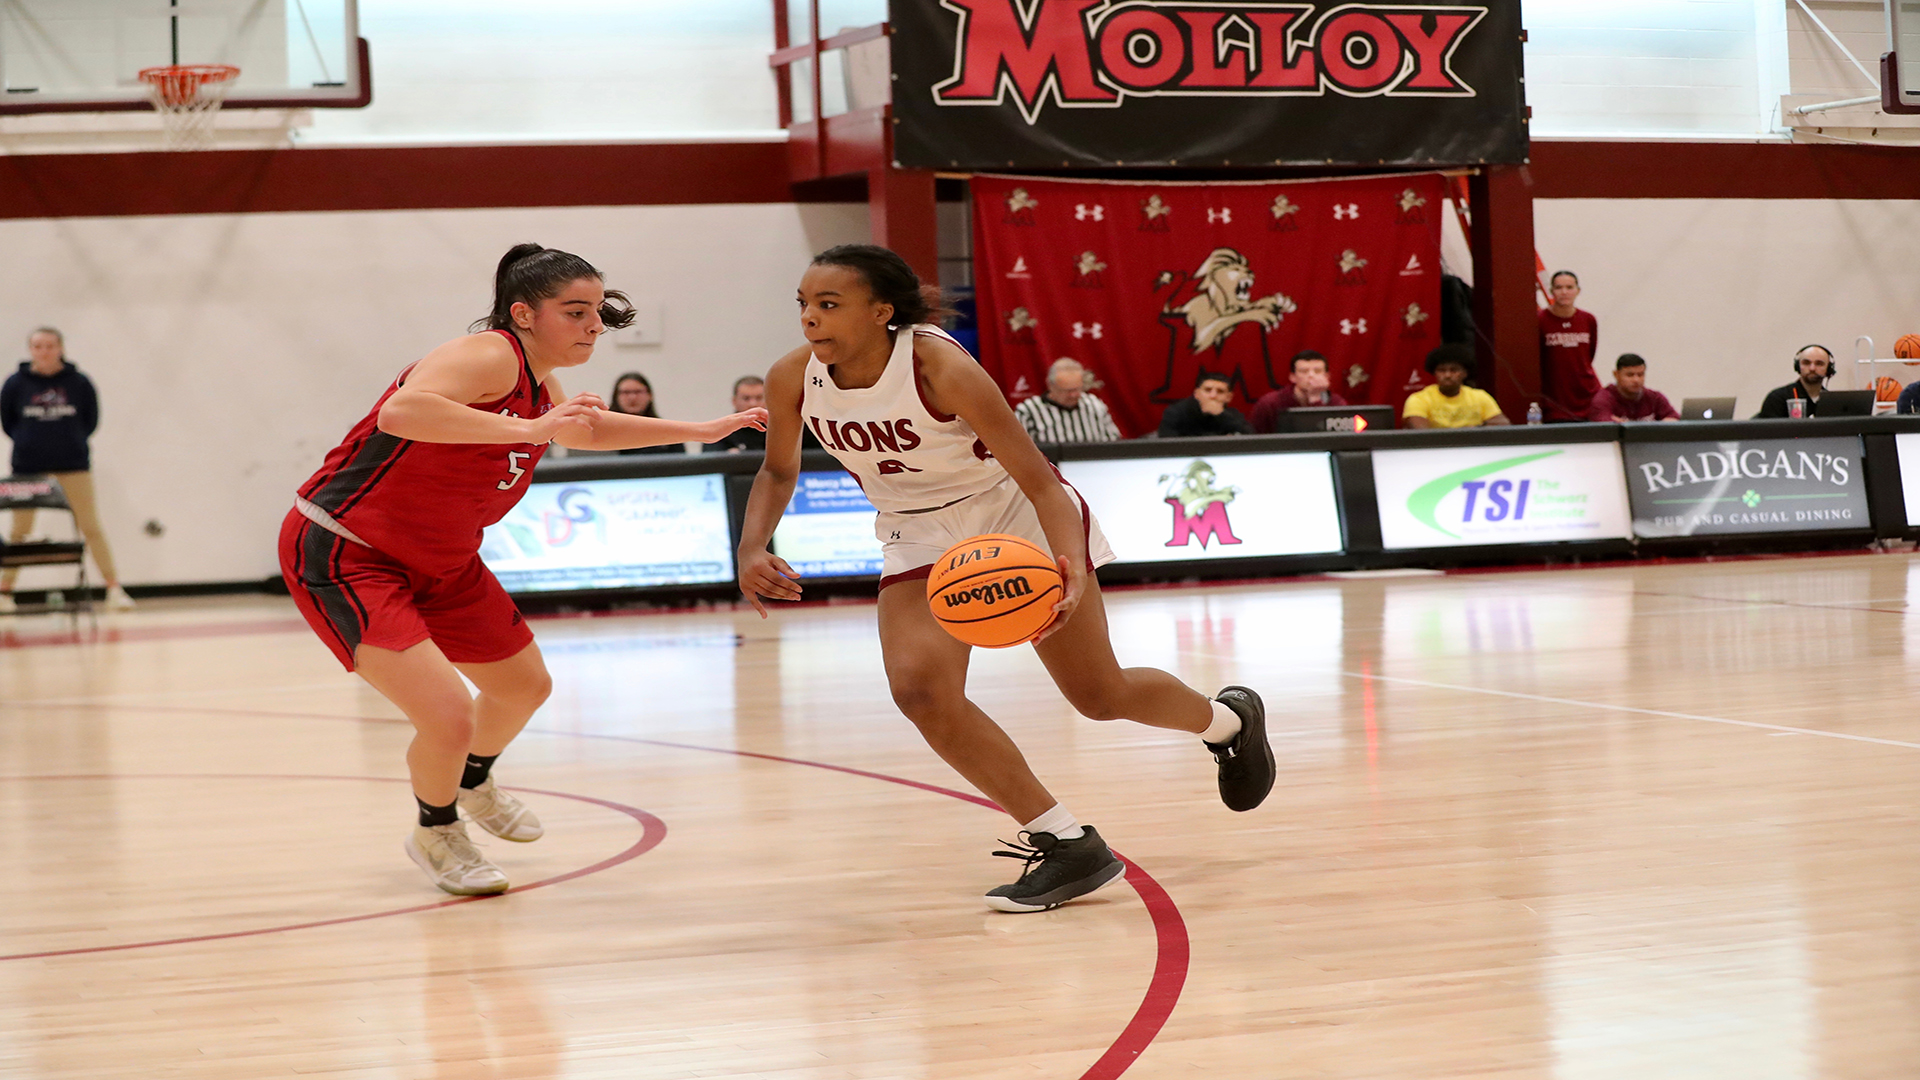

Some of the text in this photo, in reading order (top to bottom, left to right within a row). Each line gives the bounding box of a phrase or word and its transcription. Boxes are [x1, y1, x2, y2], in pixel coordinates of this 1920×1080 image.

[932, 0, 1488, 125] MOLLOY
[810, 415, 922, 453] LIONS
[496, 450, 531, 491] 5
[1536, 479, 1561, 490] The
[1639, 448, 1849, 493] RADIGAN'S
[1461, 478, 1531, 524] TSI
[1692, 514, 1724, 526] AND
[1729, 511, 1790, 525] CASUAL
[1795, 508, 1852, 522] DINING
[949, 546, 1002, 571] EVO
[943, 575, 1034, 608] Wilson
